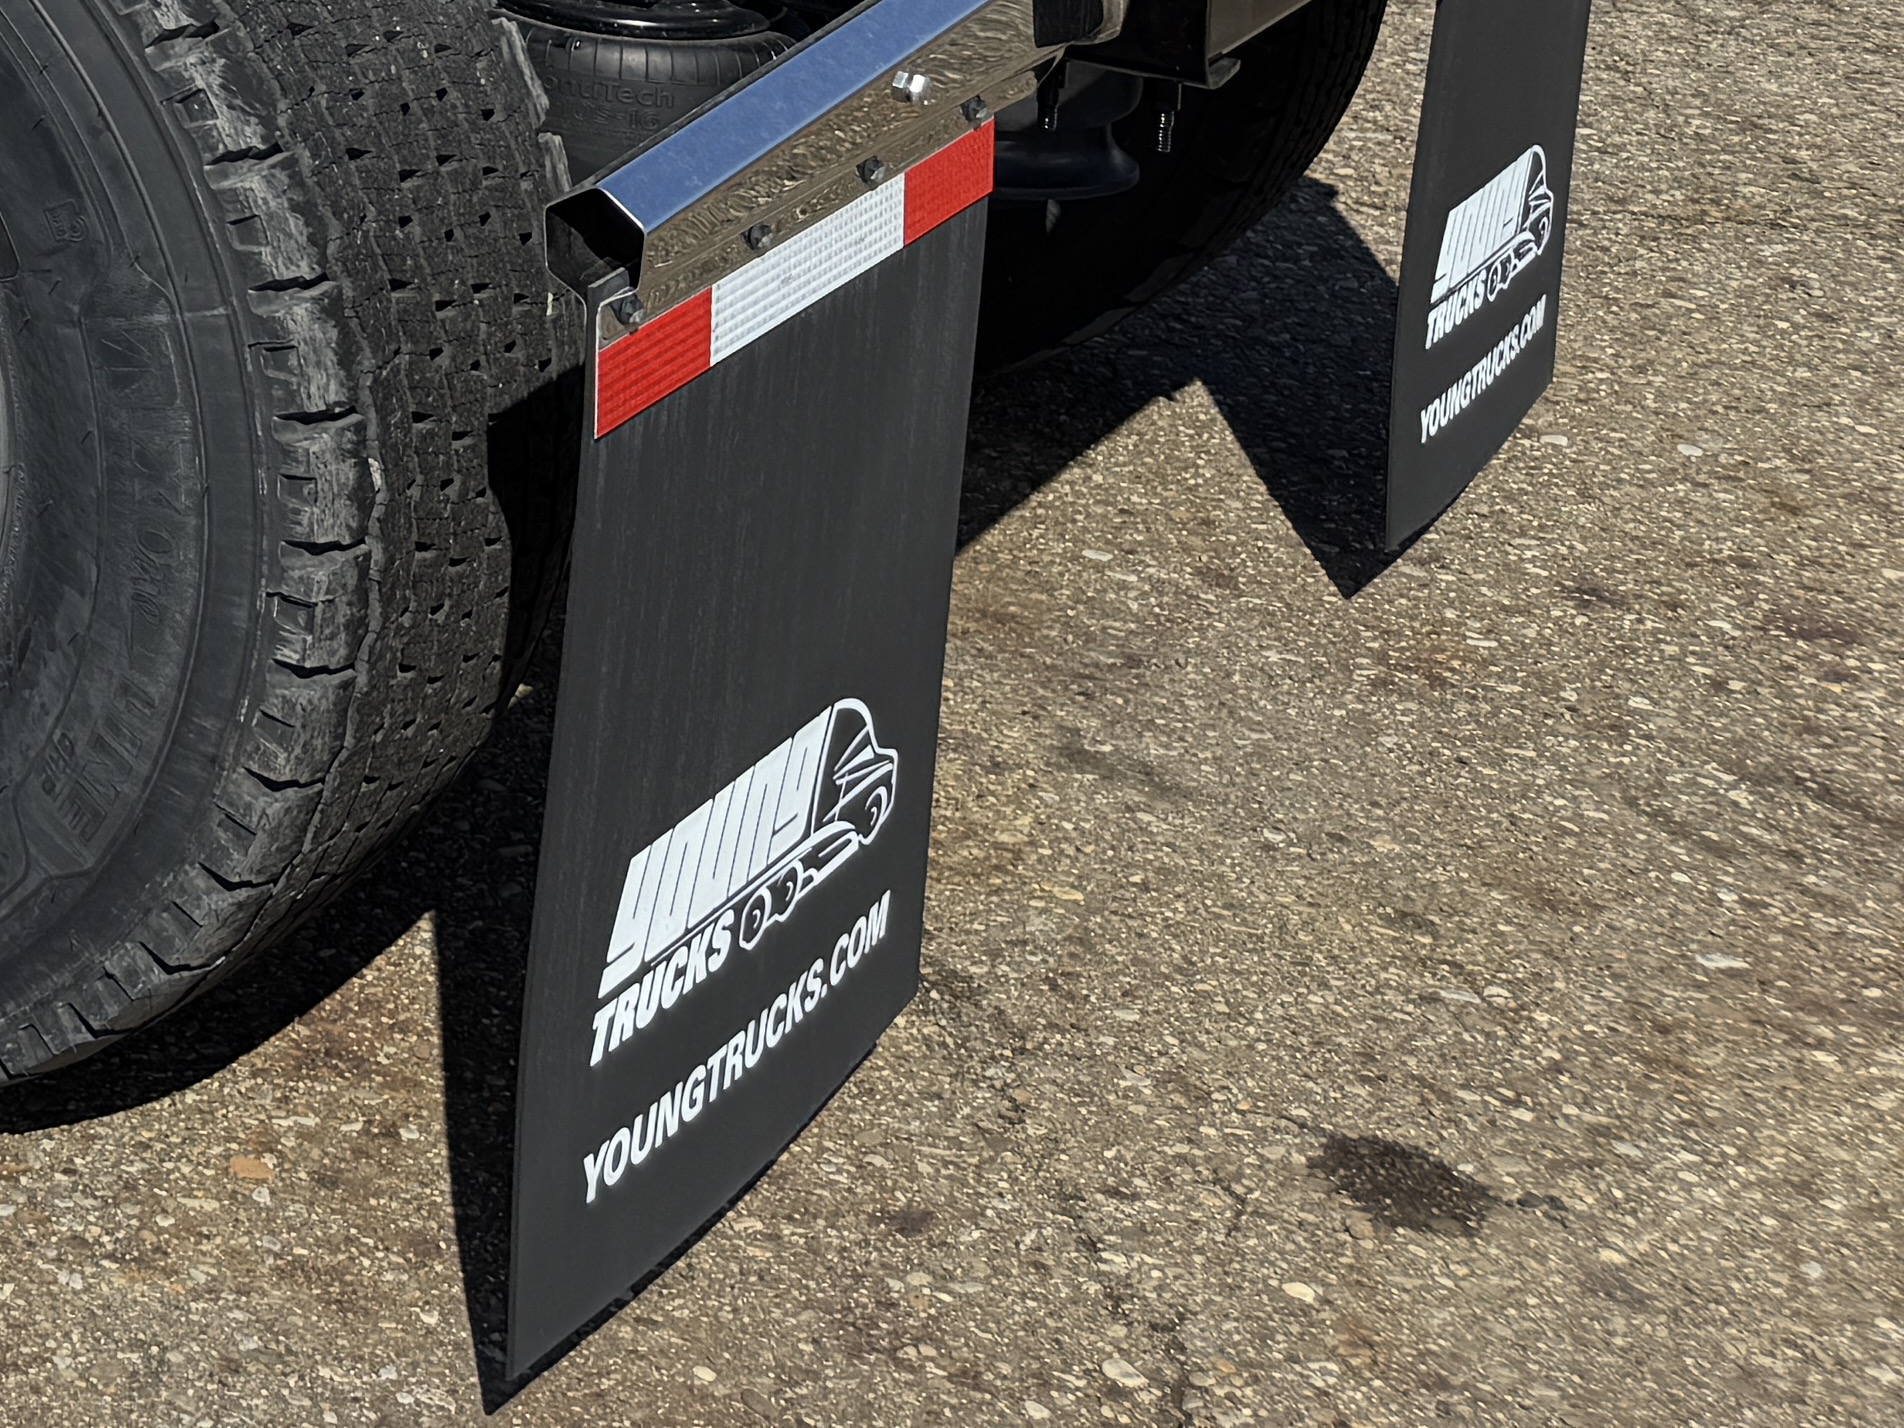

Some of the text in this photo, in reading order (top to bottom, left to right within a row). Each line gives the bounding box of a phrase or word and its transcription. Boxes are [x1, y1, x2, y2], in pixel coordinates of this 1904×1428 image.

[1420, 294, 1546, 444] YOUNGTRUCKS.COM
[1425, 269, 1486, 350] TRUCKS
[582, 889, 892, 1205] YOUNGTRUCKS.COM
[589, 907, 735, 1067] TRUCKS
